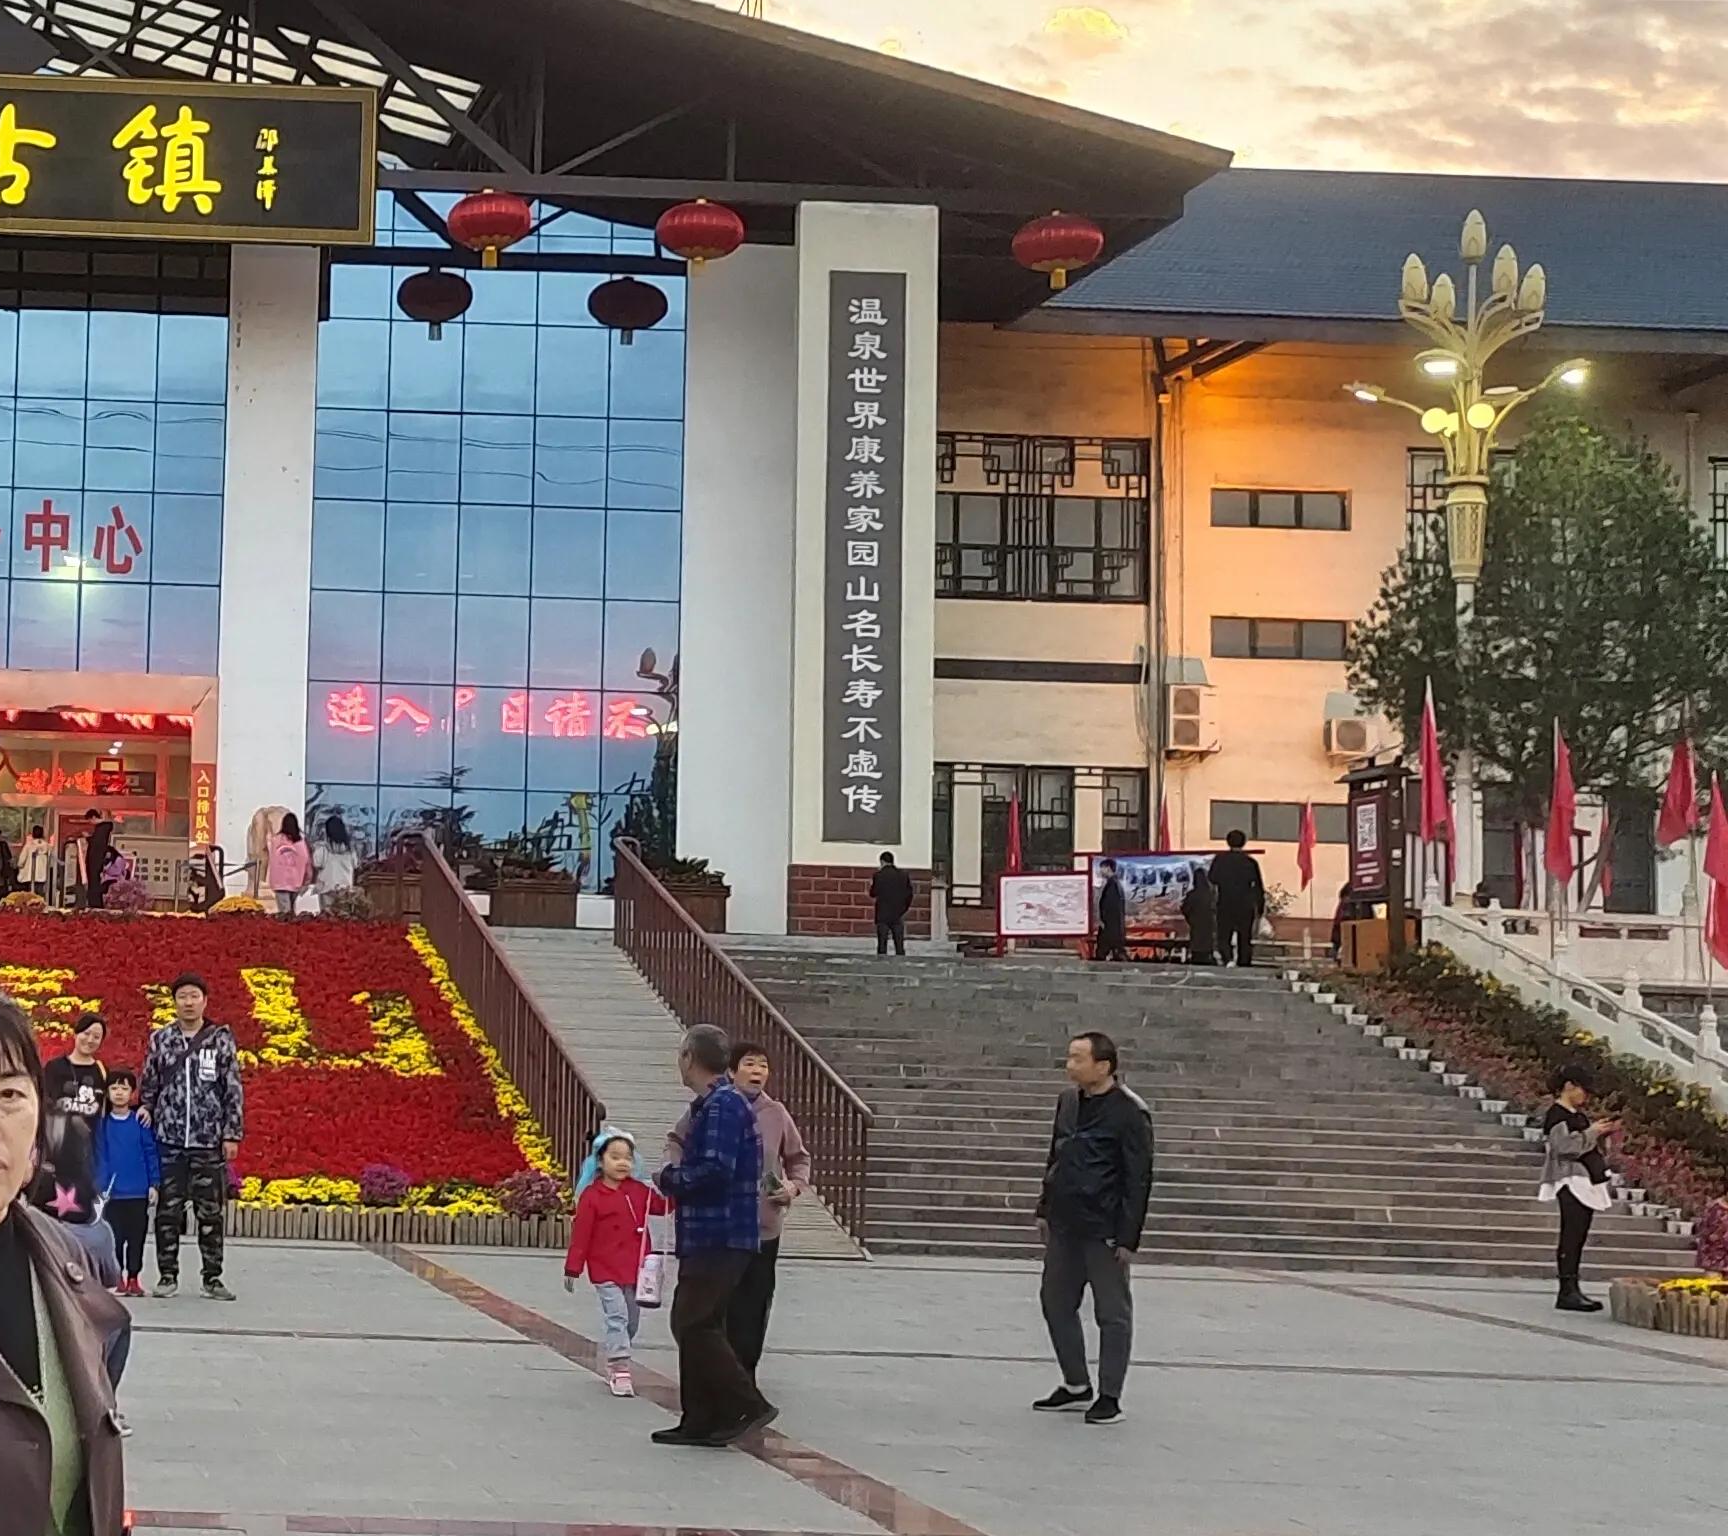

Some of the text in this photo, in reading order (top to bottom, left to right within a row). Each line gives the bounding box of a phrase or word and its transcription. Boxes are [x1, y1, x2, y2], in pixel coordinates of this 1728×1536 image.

[840, 298, 889, 814] 温泉世界康养家园山名长寿不虚传
[195, 769, 211, 844] 入口排队处
